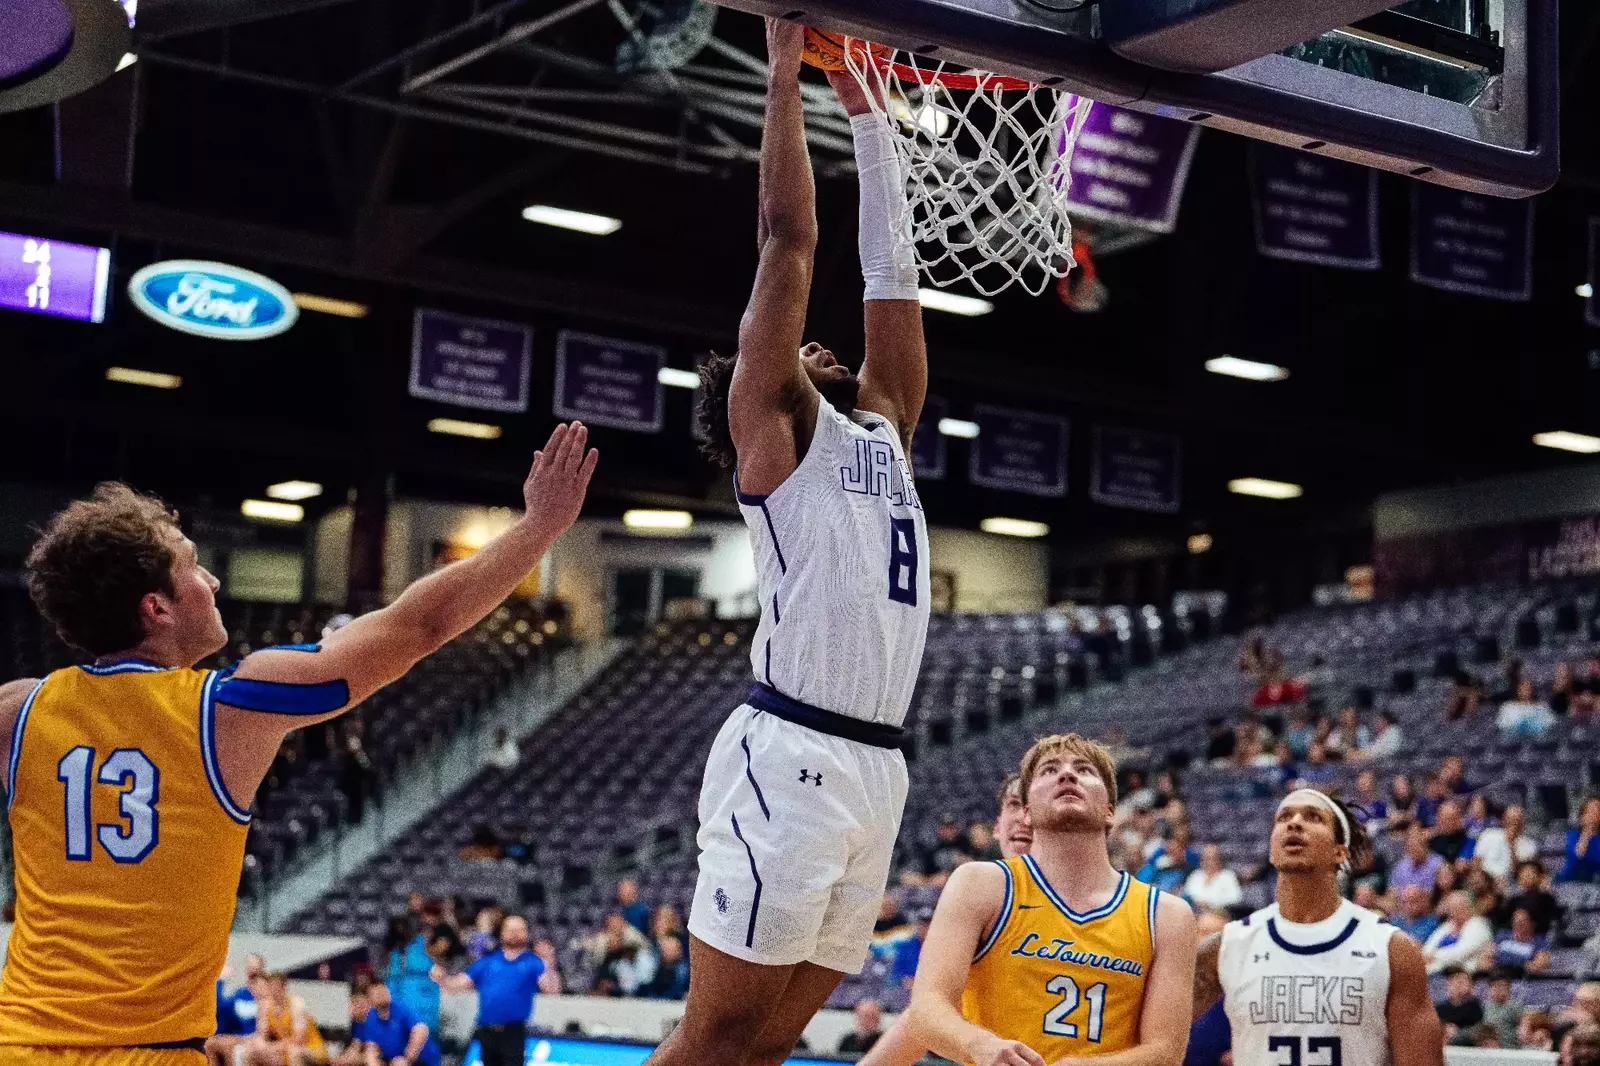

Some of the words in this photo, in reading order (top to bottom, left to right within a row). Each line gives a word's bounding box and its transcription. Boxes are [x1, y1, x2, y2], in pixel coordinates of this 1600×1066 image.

[167, 272, 257, 325] Ford
[888, 514, 918, 608] 8
[57, 744, 160, 865] 13
[1010, 932, 1143, 977] LeTourneau
[1042, 974, 1108, 1045] 21
[1249, 974, 1365, 1027] JACKS
